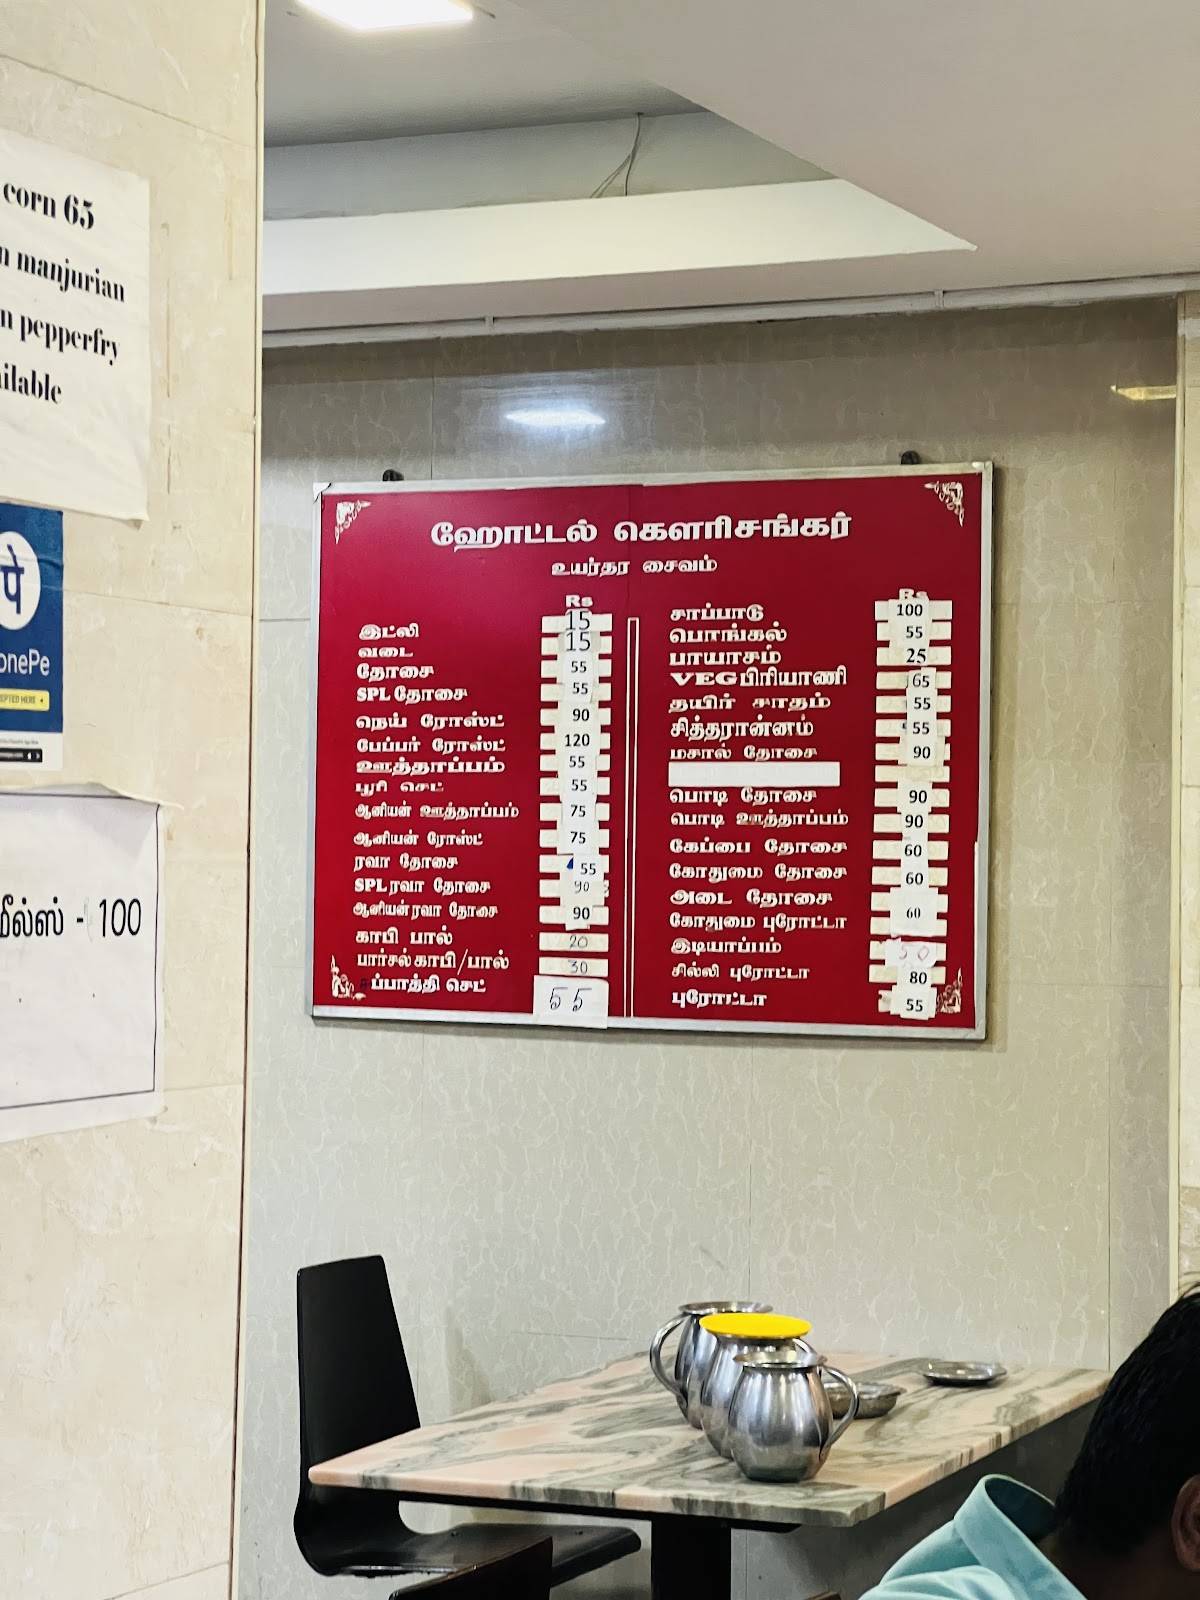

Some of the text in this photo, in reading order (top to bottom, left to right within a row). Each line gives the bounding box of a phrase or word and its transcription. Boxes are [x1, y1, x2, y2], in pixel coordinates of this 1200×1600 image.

[2, 181, 96, 231] corn 65
[17, 250, 125, 303] manjurian
[20, 313, 121, 366] pepperfry
[431, 518, 598, 553] ஹோட்டல்
[551, 554, 718, 578] உயர்தர சைவம்
[565, 594, 594, 608] Rs
[896, 603, 923, 617] 100
[565, 610, 591, 631] 15
[670, 602, 764, 621] சாப்பாடு
[358, 622, 420, 640] இட்லி
[669, 621, 787, 644] பொங்கல்
[905, 626, 923, 639] 55
[565, 631, 591, 652] 15
[358, 646, 414, 658] வடை
[669, 644, 782, 666] பாயாசம்
[906, 648, 927, 664] 25
[356, 662, 435, 683] தோசை
[571, 661, 587, 673] 55
[572, 682, 588, 695] 55
[912, 672, 930, 688] 65
[394, 685, 468, 706] தோசை
[669, 691, 832, 713] தயிர் சாதம்
[913, 697, 931, 710] 55
[356, 710, 505, 732] நெய் ரோஸ்ட்
[572, 708, 590, 722] 90
[670, 714, 814, 742] சித்தரான்னம்
[912, 722, 930, 734] 55
[356, 734, 506, 755] பேப்பர் ரோஸ்ட்
[564, 733, 590, 747] 120
[568, 756, 586, 768] 55
[670, 742, 818, 762] மசால் தோசை
[913, 746, 931, 759] 90
[356, 755, 506, 777] ஊத்தாப்பம்
[355, 779, 444, 797] பூரி செட்
[570, 779, 588, 791] 55
[669, 786, 817, 807] பொடி தோசை
[908, 790, 928, 804] 90
[355, 800, 520, 821] ஆனியன் ஊத்தாப்பம்
[570, 805, 587, 818] 75
[670, 808, 849, 829] பொடி ஊத்தாப்பம்
[904, 815, 924, 829] 90
[353, 829, 484, 849] ஆனியன் ரோஸ்ட்
[569, 831, 587, 844] 75
[669, 836, 848, 857] கேப்பை தோசை
[904, 844, 922, 858] 60
[353, 852, 459, 873] ரவா தோசை
[580, 863, 597, 875] 55
[669, 862, 848, 884] கோதுமை தோசை
[905, 872, 924, 885] 60
[433, 877, 491, 897] தோசை
[670, 888, 833, 909] அடை தோசை
[99, 898, 142, 937] 100
[449, 901, 499, 921] தோசை
[573, 907, 590, 920] 90
[906, 907, 921, 919] 60
[669, 912, 848, 933] கோதுமை புரோட்டா
[355, 925, 453, 945] காபி பால்
[569, 935, 588, 949] 20
[670, 936, 782, 956] இடியாப்பம்
[357, 947, 411, 968] பார்சல்
[568, 960, 588, 974] 30
[672, 961, 810, 982] சில்லி புரோட்டா
[909, 971, 928, 984] 80
[371, 972, 487, 995] ப்பாத்தி செட்
[672, 988, 768, 1008] புரோட்டா
[906, 999, 923, 1012] 55
